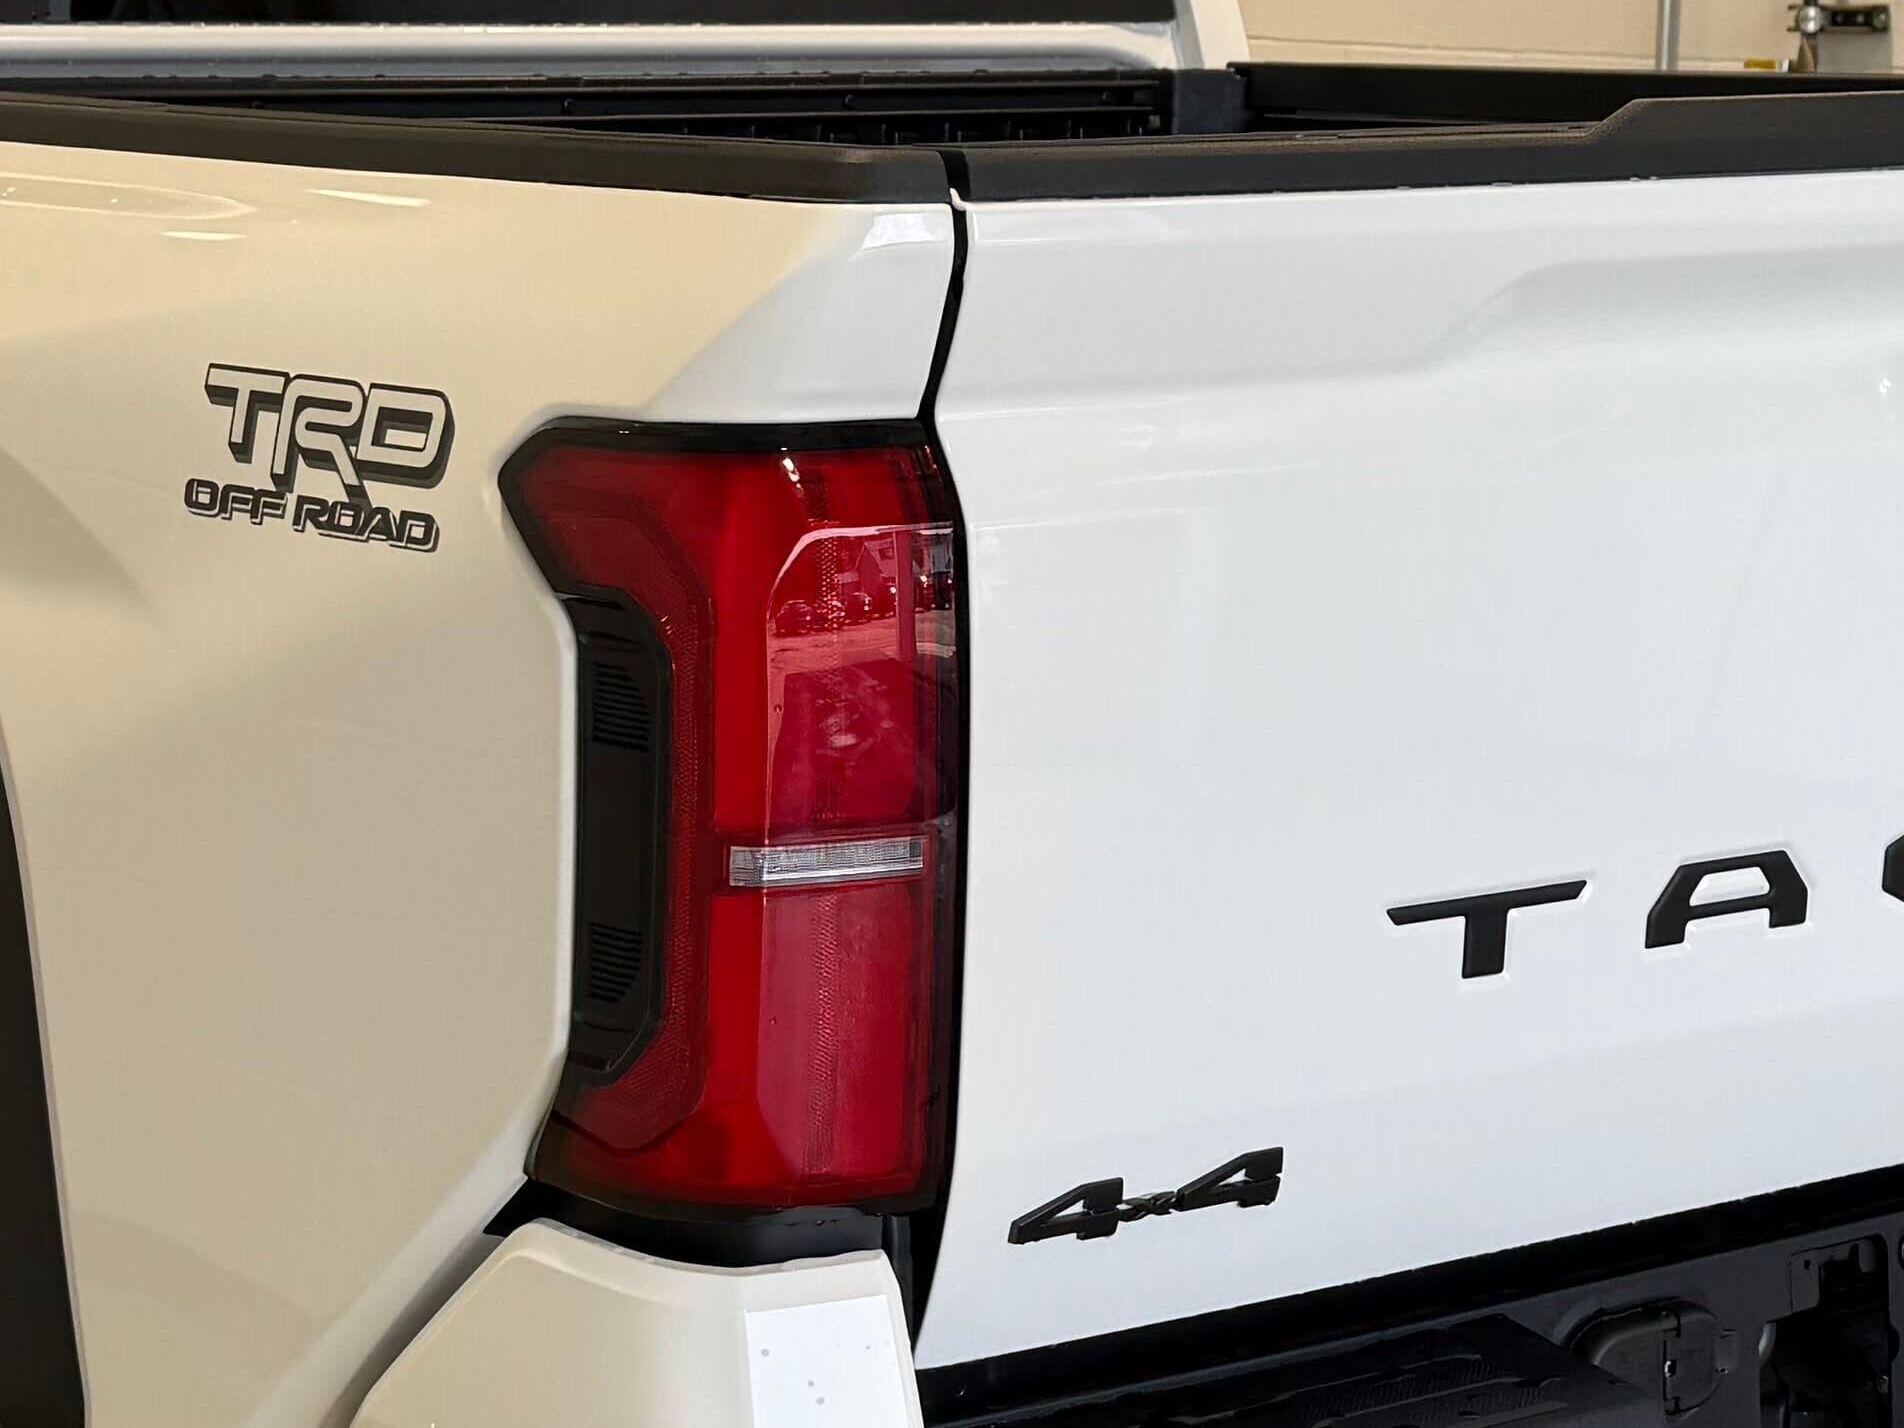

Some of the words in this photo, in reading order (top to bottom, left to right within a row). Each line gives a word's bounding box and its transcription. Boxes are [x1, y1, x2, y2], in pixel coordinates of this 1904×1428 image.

[204, 362, 456, 510] TRD
[183, 477, 289, 526] OFF
[292, 495, 440, 553] ROAD
